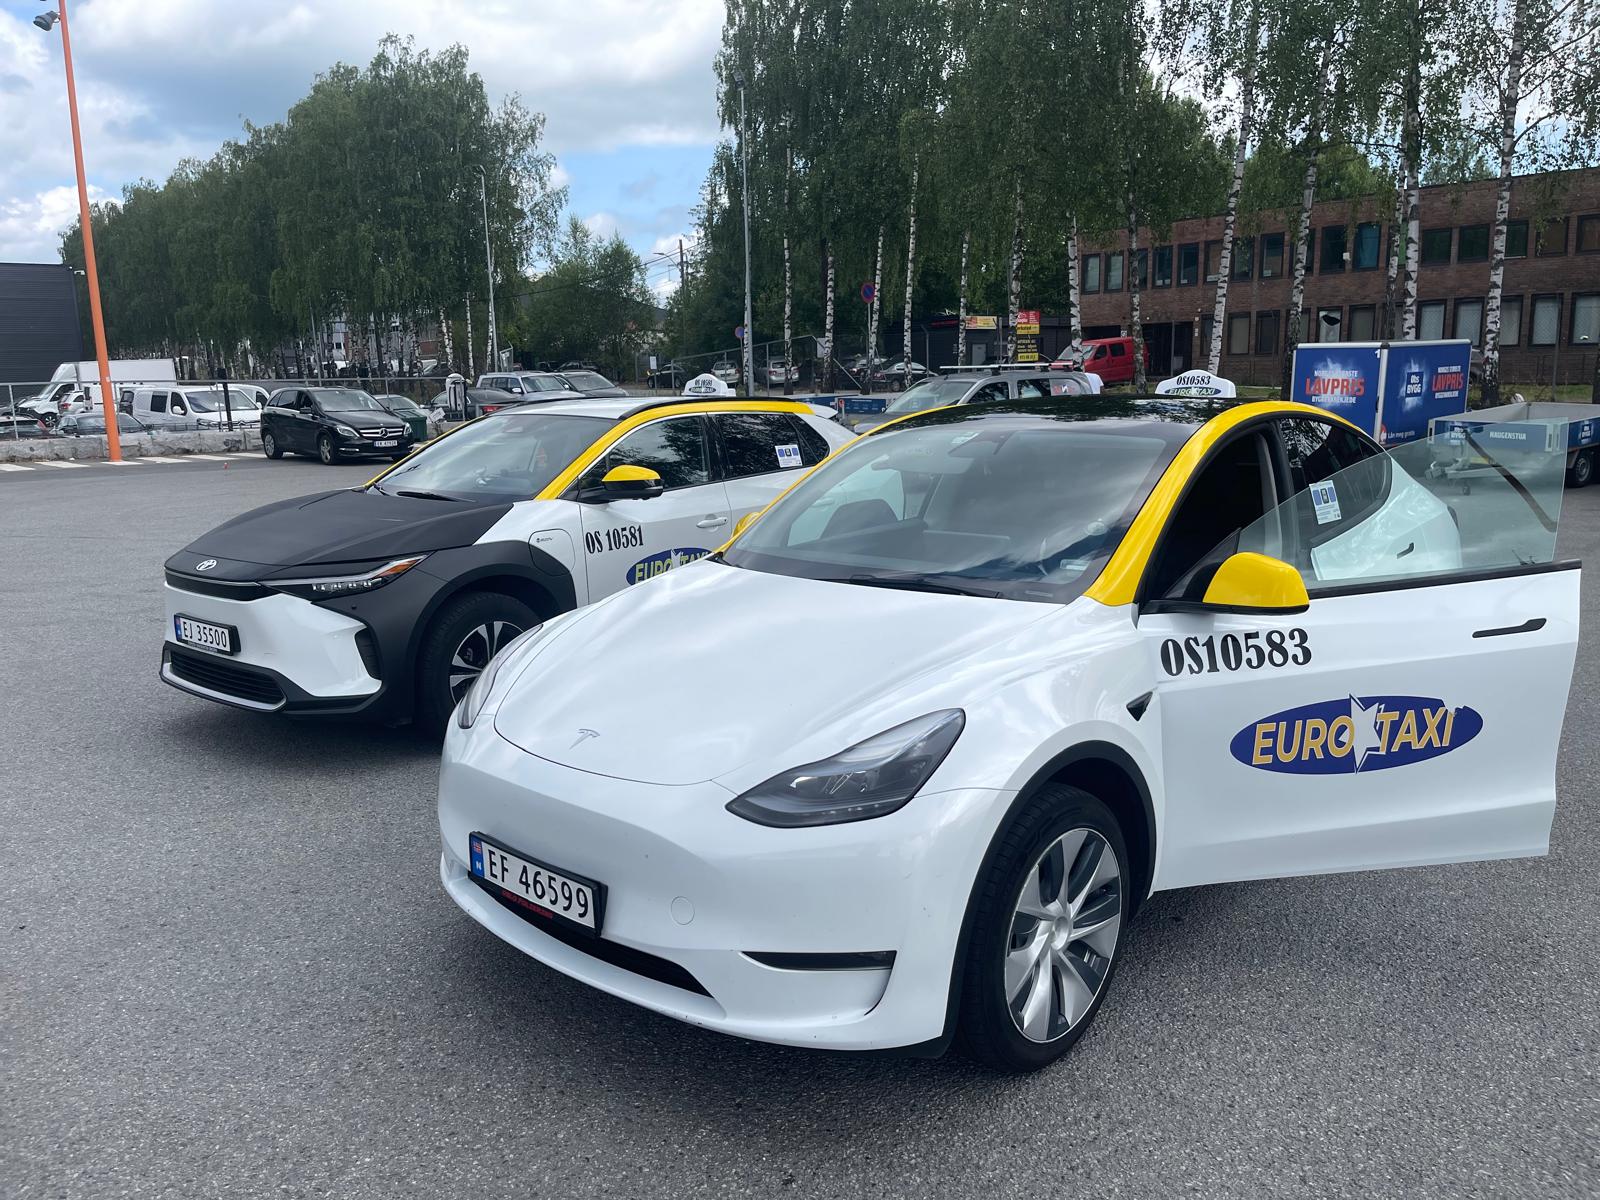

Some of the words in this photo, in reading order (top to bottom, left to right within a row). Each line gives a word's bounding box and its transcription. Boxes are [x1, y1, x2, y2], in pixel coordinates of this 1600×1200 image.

[1305, 377, 1365, 396] LAVPRIS
[1407, 384, 1421, 394] BYGG
[1432, 373, 1464, 391] LAVPRIS
[1489, 431, 1527, 440] HAUGENSTUA
[585, 530, 603, 554] OS
[606, 525, 644, 551] 10581
[183, 622, 193, 639] EJ
[197, 625, 227, 648] 35500
[1160, 628, 1312, 676] OS10583
[1252, 715, 1355, 765] EURO
[1377, 707, 1455, 754] TAXI
[487, 849, 509, 883] EF
[519, 865, 589, 918] 46599
